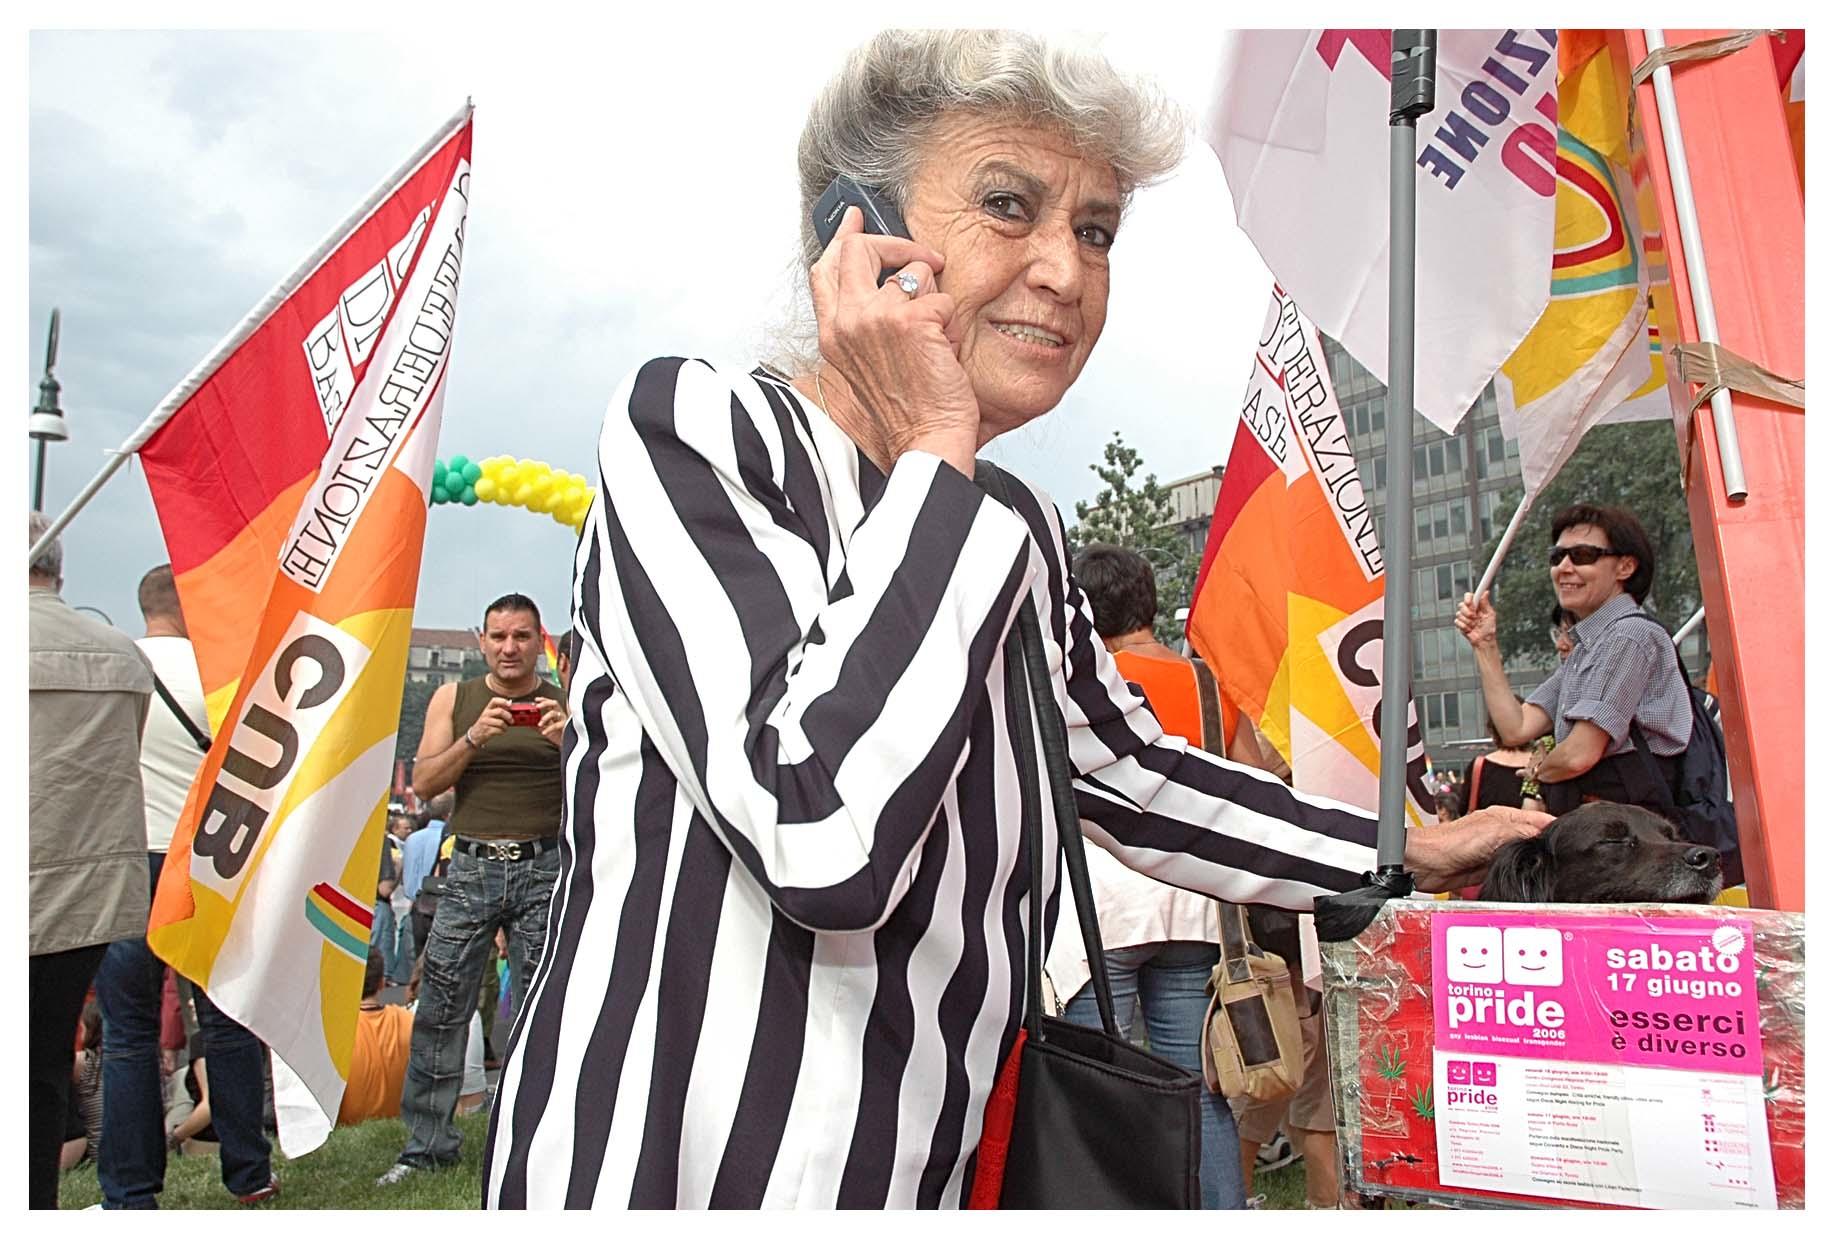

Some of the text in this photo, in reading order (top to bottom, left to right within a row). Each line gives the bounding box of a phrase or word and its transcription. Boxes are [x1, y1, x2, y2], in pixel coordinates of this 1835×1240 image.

[1606, 943, 1740, 974] sabato
[1447, 983, 1493, 997] torino
[1607, 972, 1742, 1000] 17 giugno
[1448, 989, 1565, 1029] pride
[1532, 1028, 1566, 1039] 2006
[1610, 1010, 1745, 1035] esserci
[1611, 1031, 1746, 1058] è diverso
[1447, 1088, 1498, 1105] pride
